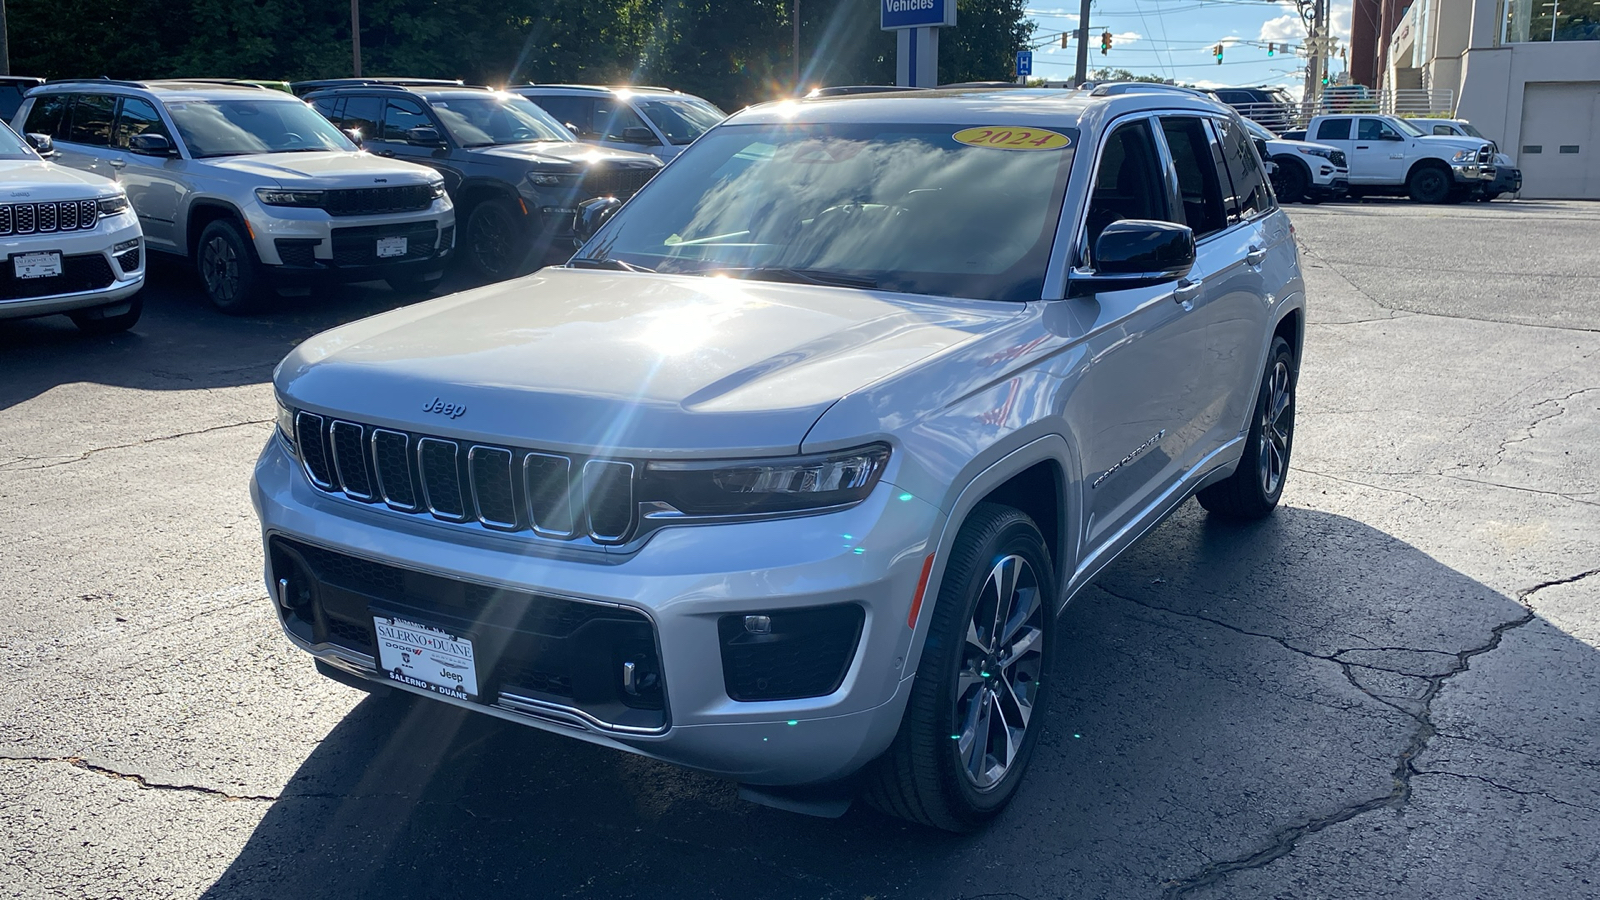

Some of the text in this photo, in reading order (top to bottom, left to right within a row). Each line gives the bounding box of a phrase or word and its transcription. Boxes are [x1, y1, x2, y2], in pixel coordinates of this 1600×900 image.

[886, 0, 934, 13] Vehicles
[1020, 57, 1029, 69] H
[967, 130, 1055, 147] 2024
[421, 396, 467, 420] Jeep
[378, 625, 472, 658] SALERNO DUANE
[440, 668, 464, 684] Jeep
[389, 671, 468, 701] SALERNO DUANE
